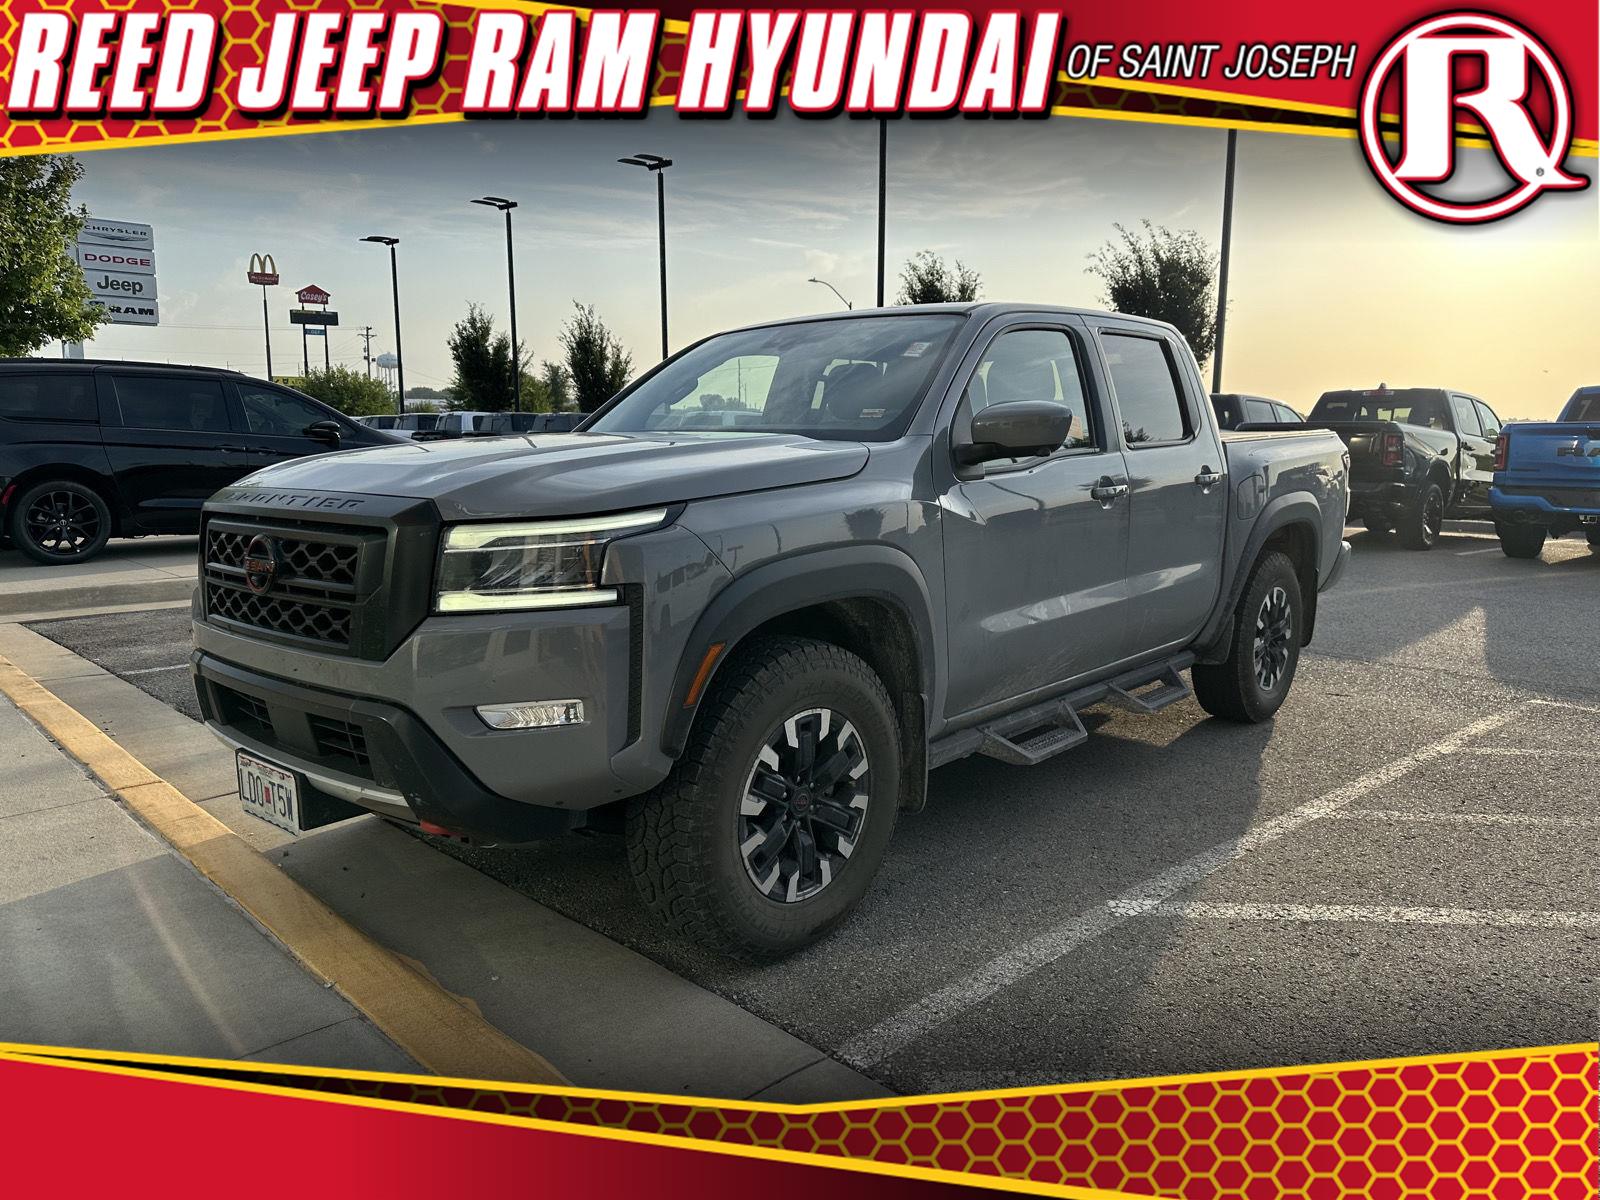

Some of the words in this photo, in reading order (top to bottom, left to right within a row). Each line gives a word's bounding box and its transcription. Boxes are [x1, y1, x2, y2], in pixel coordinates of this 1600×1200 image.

[84, 225, 147, 236] CHRYSLER
[84, 253, 151, 267] DODGE
[96, 275, 144, 295] Jeep
[300, 291, 328, 303] Casey's
[109, 306, 154, 316] RAM
